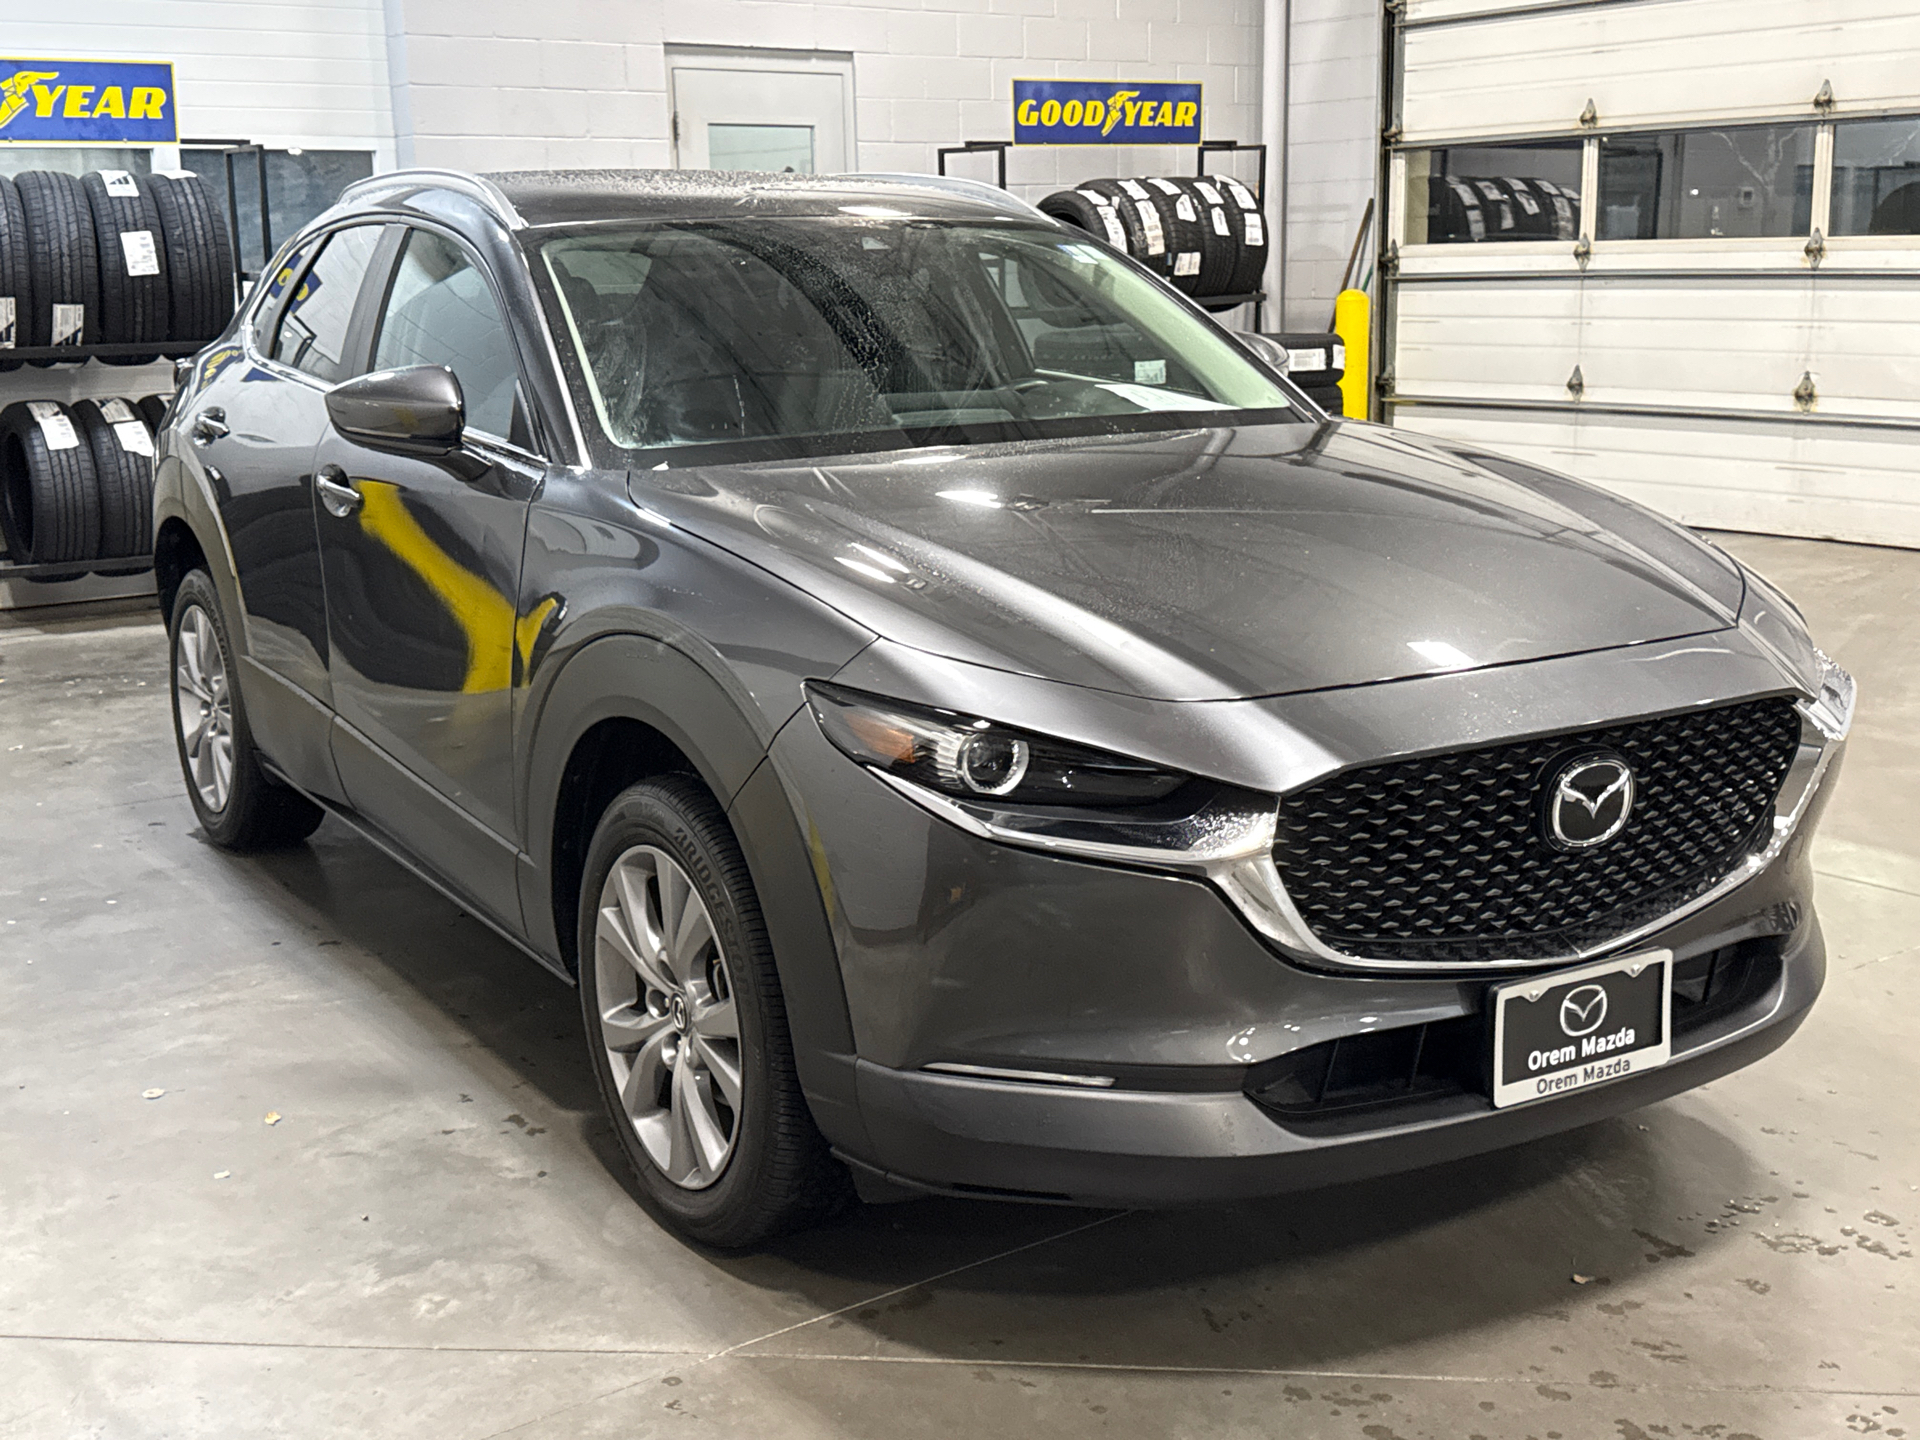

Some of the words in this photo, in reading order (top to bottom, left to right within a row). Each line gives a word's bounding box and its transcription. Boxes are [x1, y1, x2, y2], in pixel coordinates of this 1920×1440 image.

[31, 85, 167, 119] YEAR
[674, 826, 751, 1006] BRIDGESTON
[1528, 1045, 1576, 1070] Orem
[1582, 1027, 1635, 1057] Mazda
[1537, 1073, 1578, 1094] Orem
[1583, 1059, 1631, 1082] Mazda
